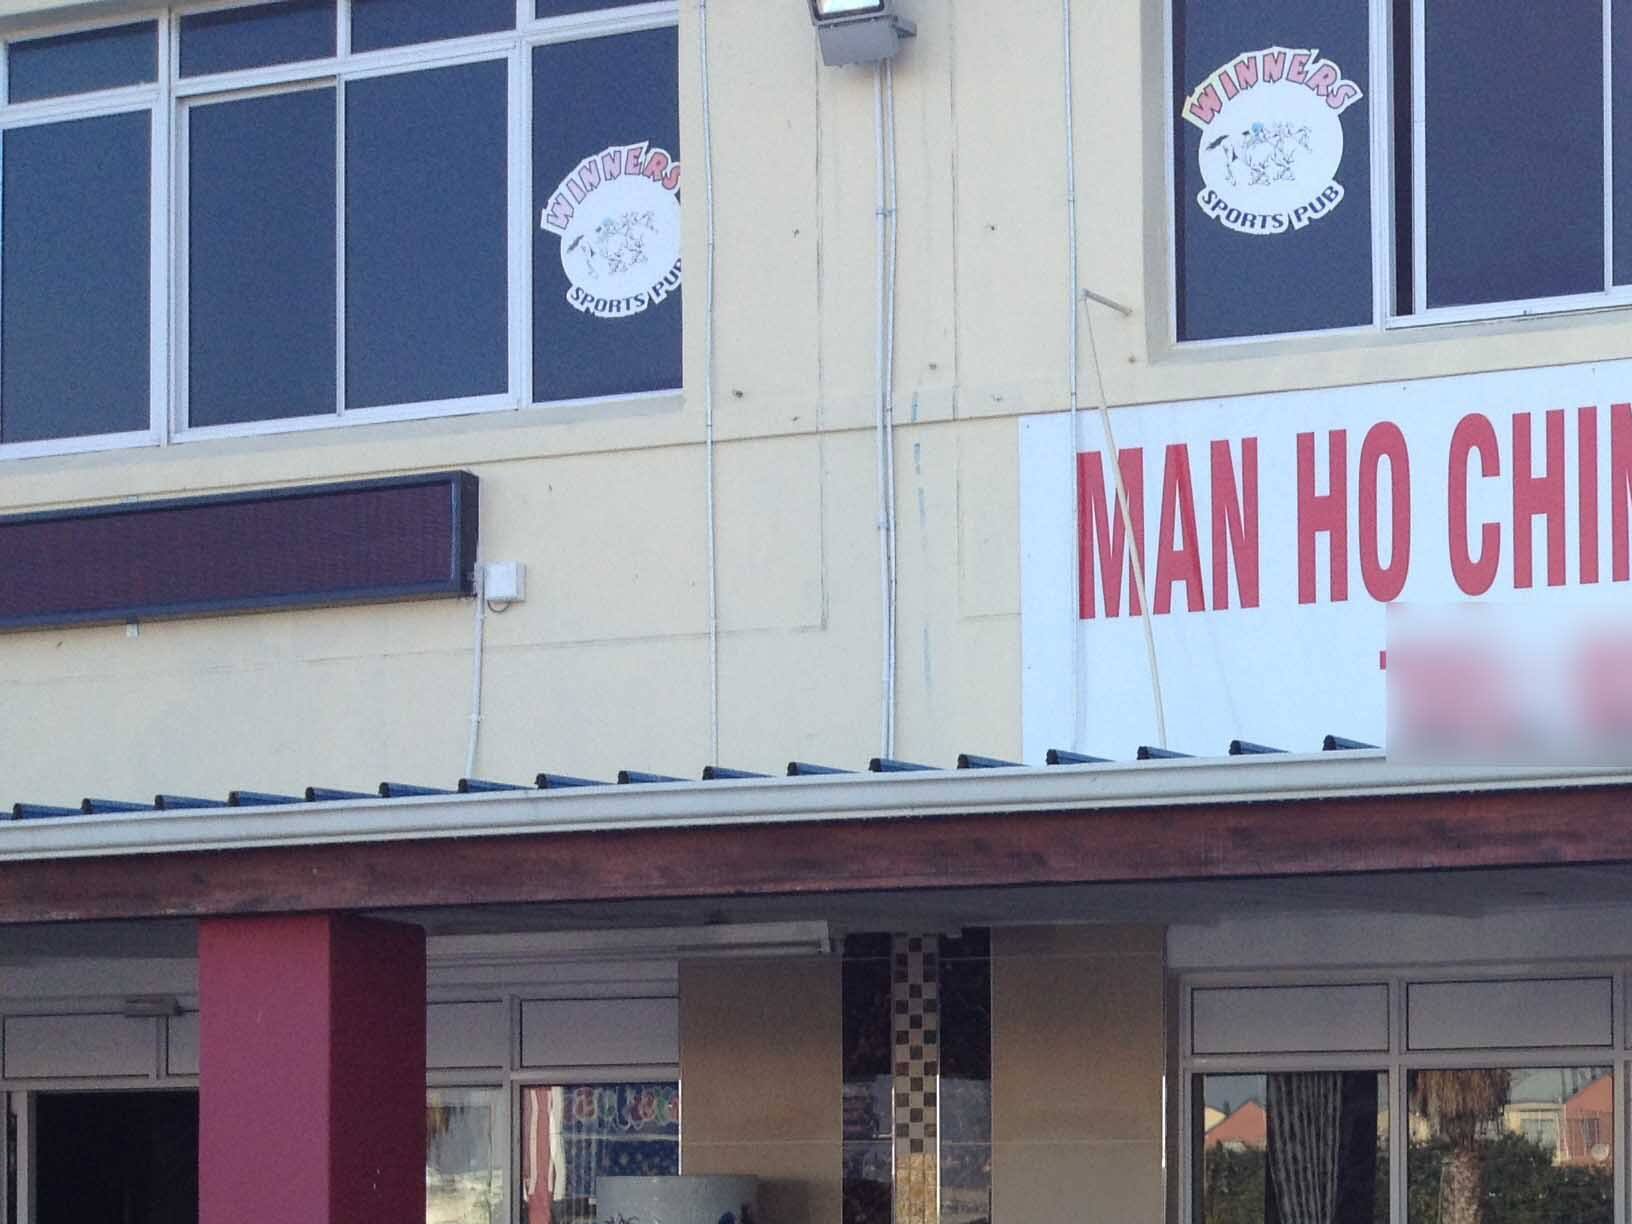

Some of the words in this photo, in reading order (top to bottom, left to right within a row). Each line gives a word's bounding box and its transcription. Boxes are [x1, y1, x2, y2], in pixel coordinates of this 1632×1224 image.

[1189, 51, 1357, 125] WINNERS
[547, 147, 680, 229] WINNERS
[1202, 189, 1286, 230] SPORTS
[1293, 184, 1340, 223] PUB
[569, 285, 646, 313] SPORTS
[1077, 436, 1260, 620] MAN
[1296, 421, 1411, 604] HO
